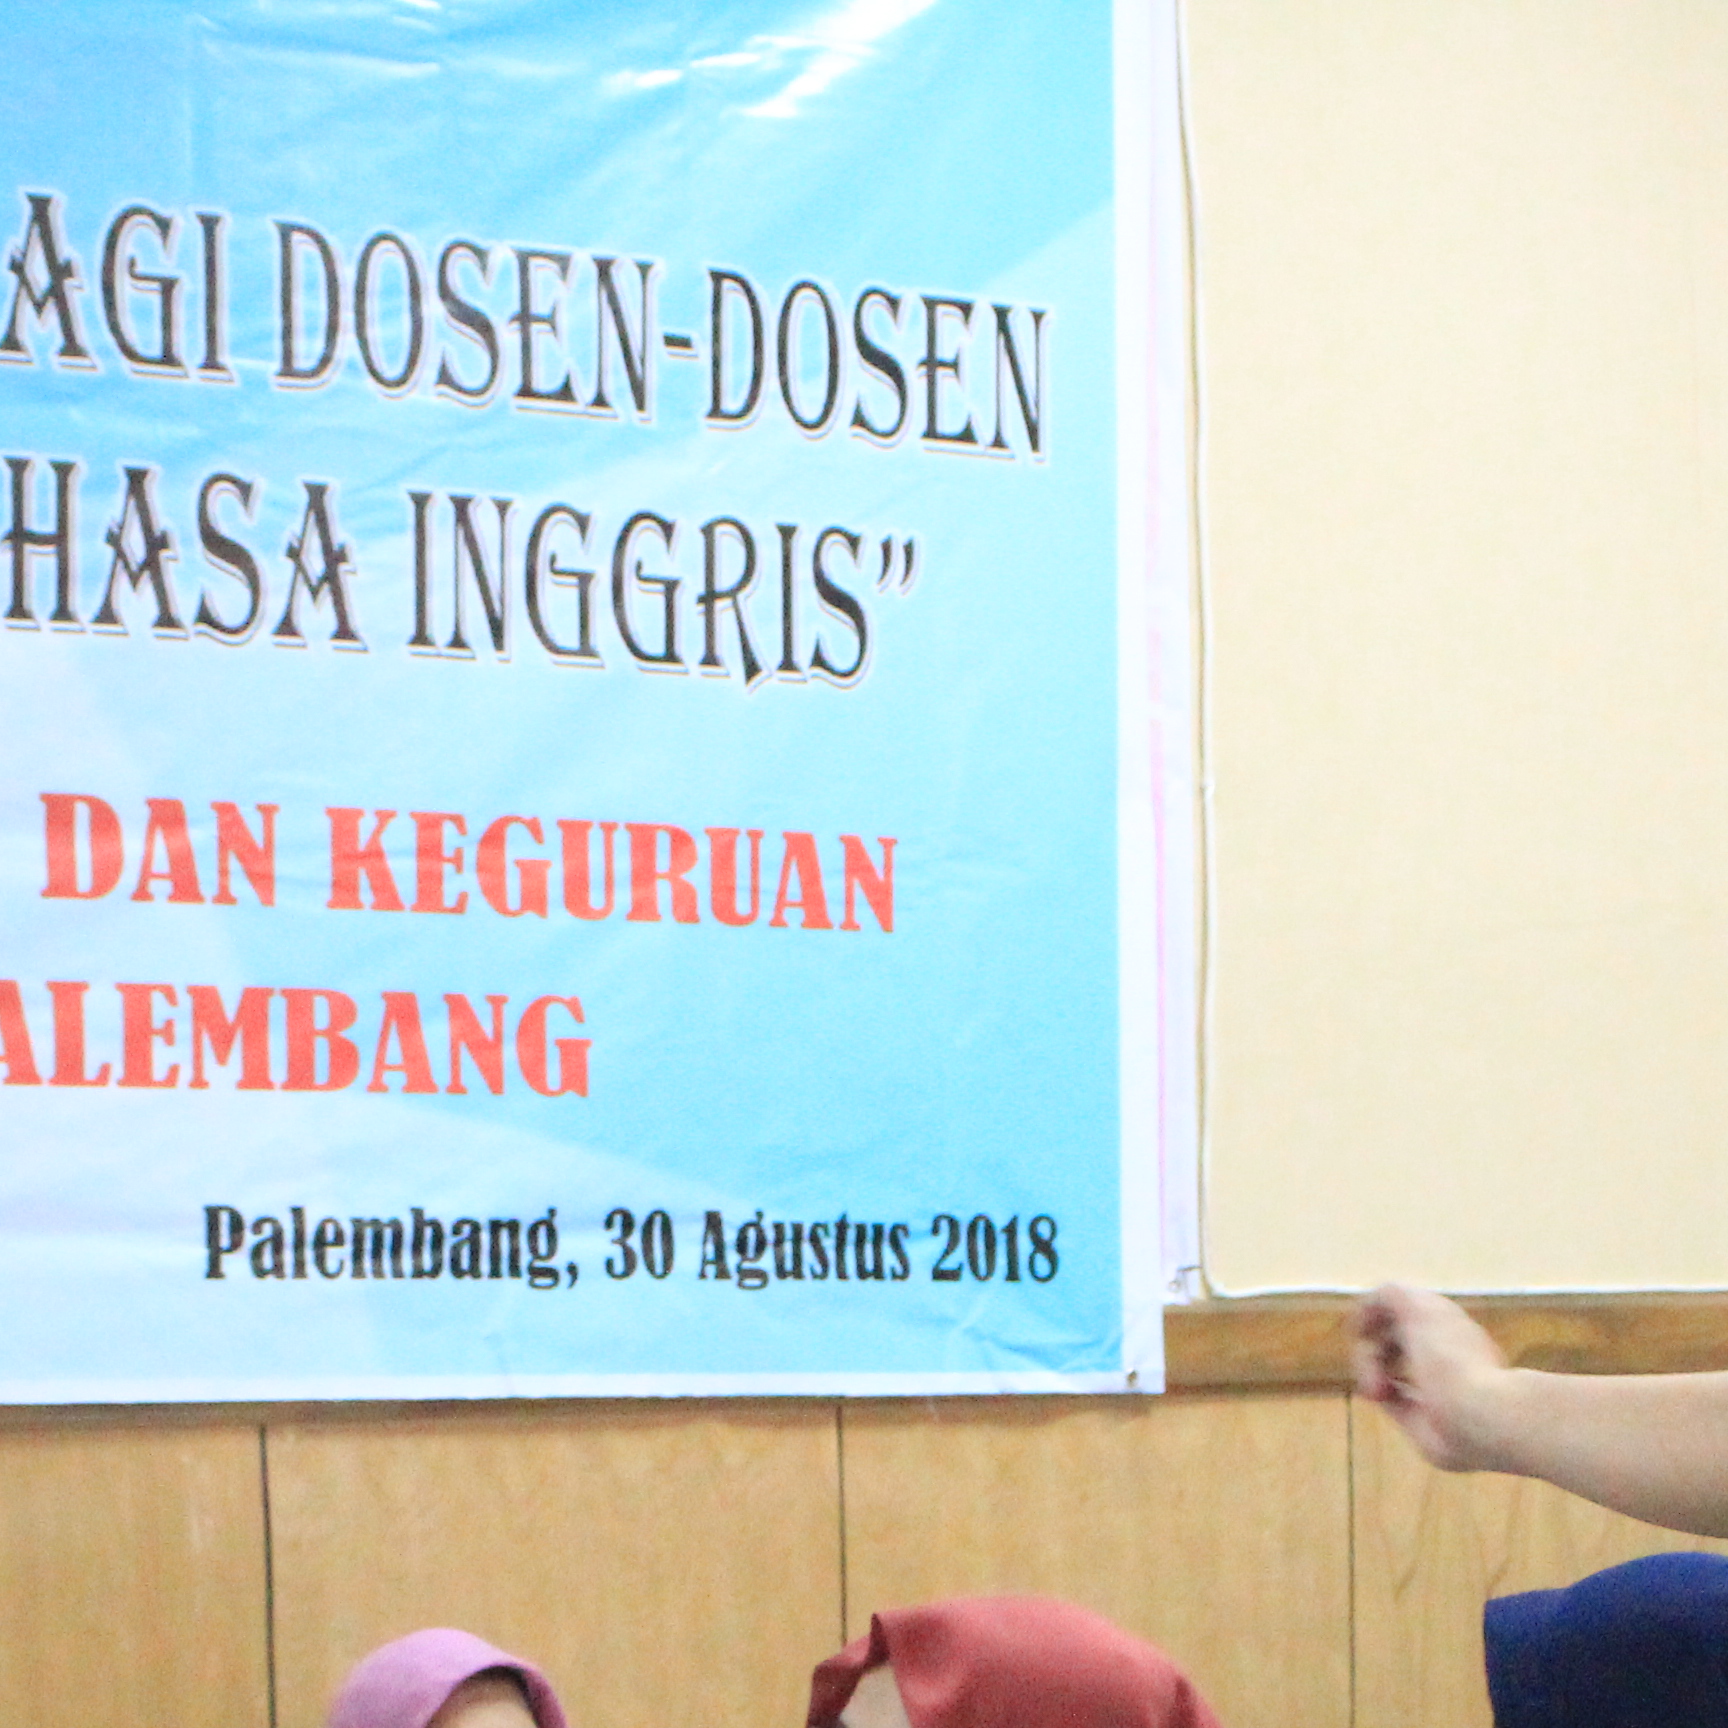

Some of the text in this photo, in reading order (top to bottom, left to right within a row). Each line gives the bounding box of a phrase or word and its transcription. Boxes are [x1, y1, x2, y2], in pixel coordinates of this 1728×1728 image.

[278, 220, 1047, 456] DOSEN-DOSEN
[41, 793, 279, 905] DAN
[324, 808, 898, 933] KEGURUAN
[205, 1206, 1059, 1290] Palembang, 30 Agustus 2018
